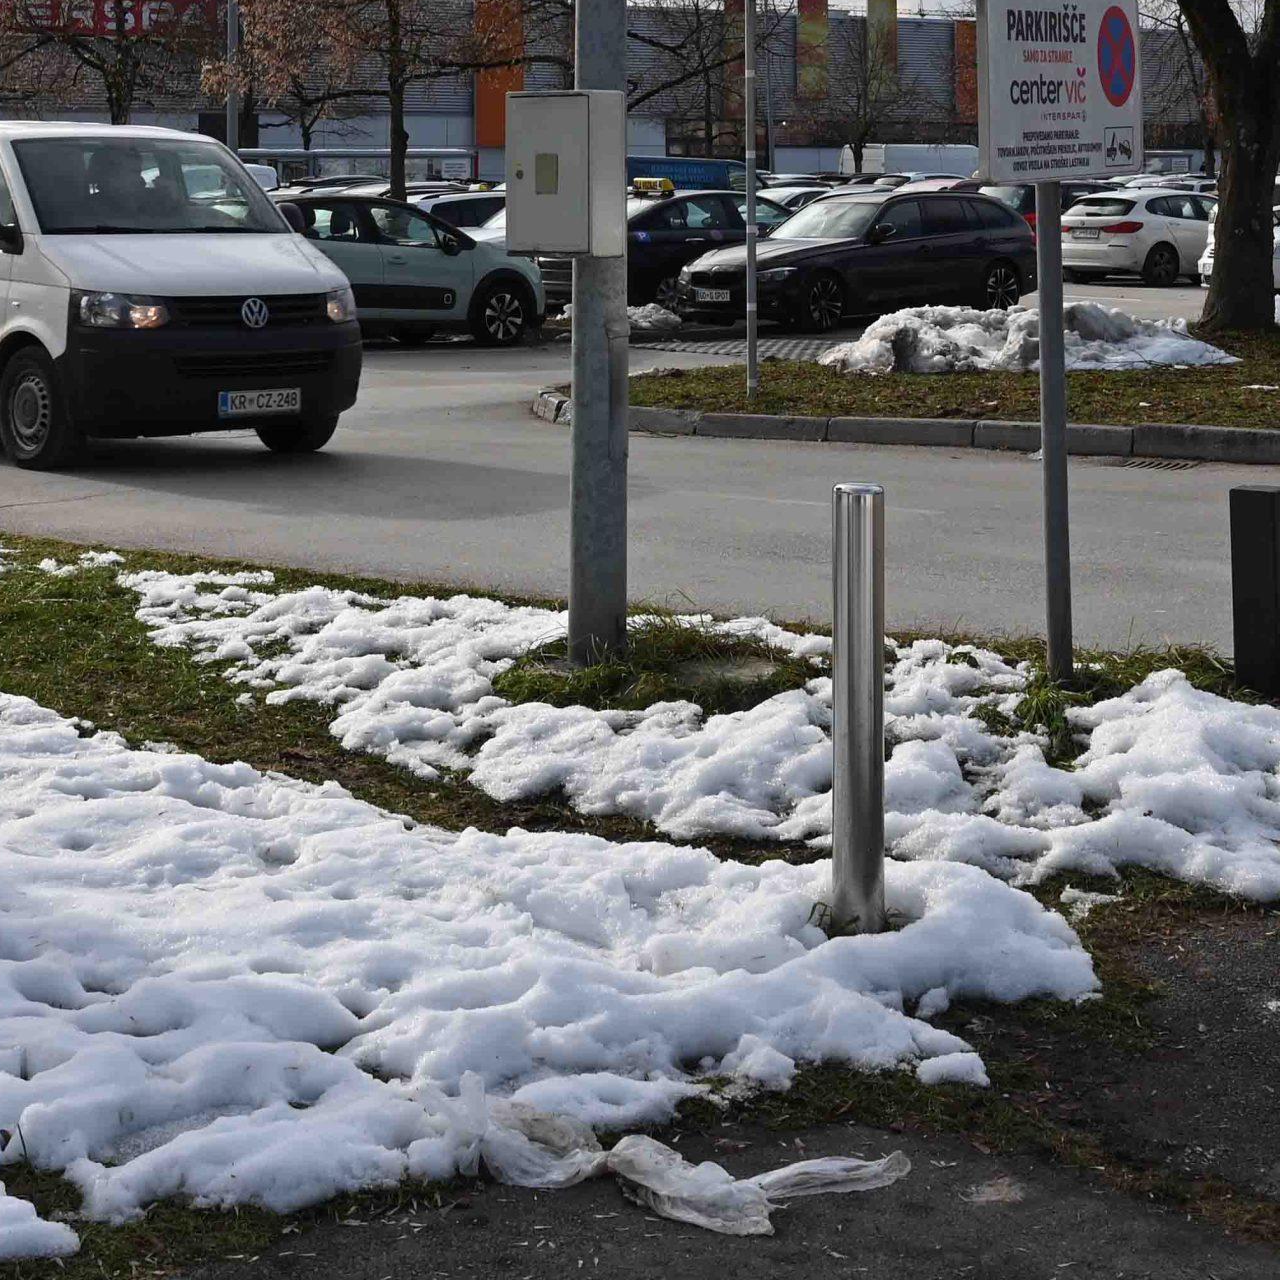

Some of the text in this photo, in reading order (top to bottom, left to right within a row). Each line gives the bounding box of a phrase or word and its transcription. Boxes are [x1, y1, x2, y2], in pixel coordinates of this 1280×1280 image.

[1006, 4, 1087, 43] PARKIRIŠČE
[1023, 49, 1074, 64] SAMO ZA STRANKE
[1010, 67, 1087, 105] center vič
[1040, 111, 1081, 121] INTERSPAR
[230, 391, 298, 410] KR CZ-248
